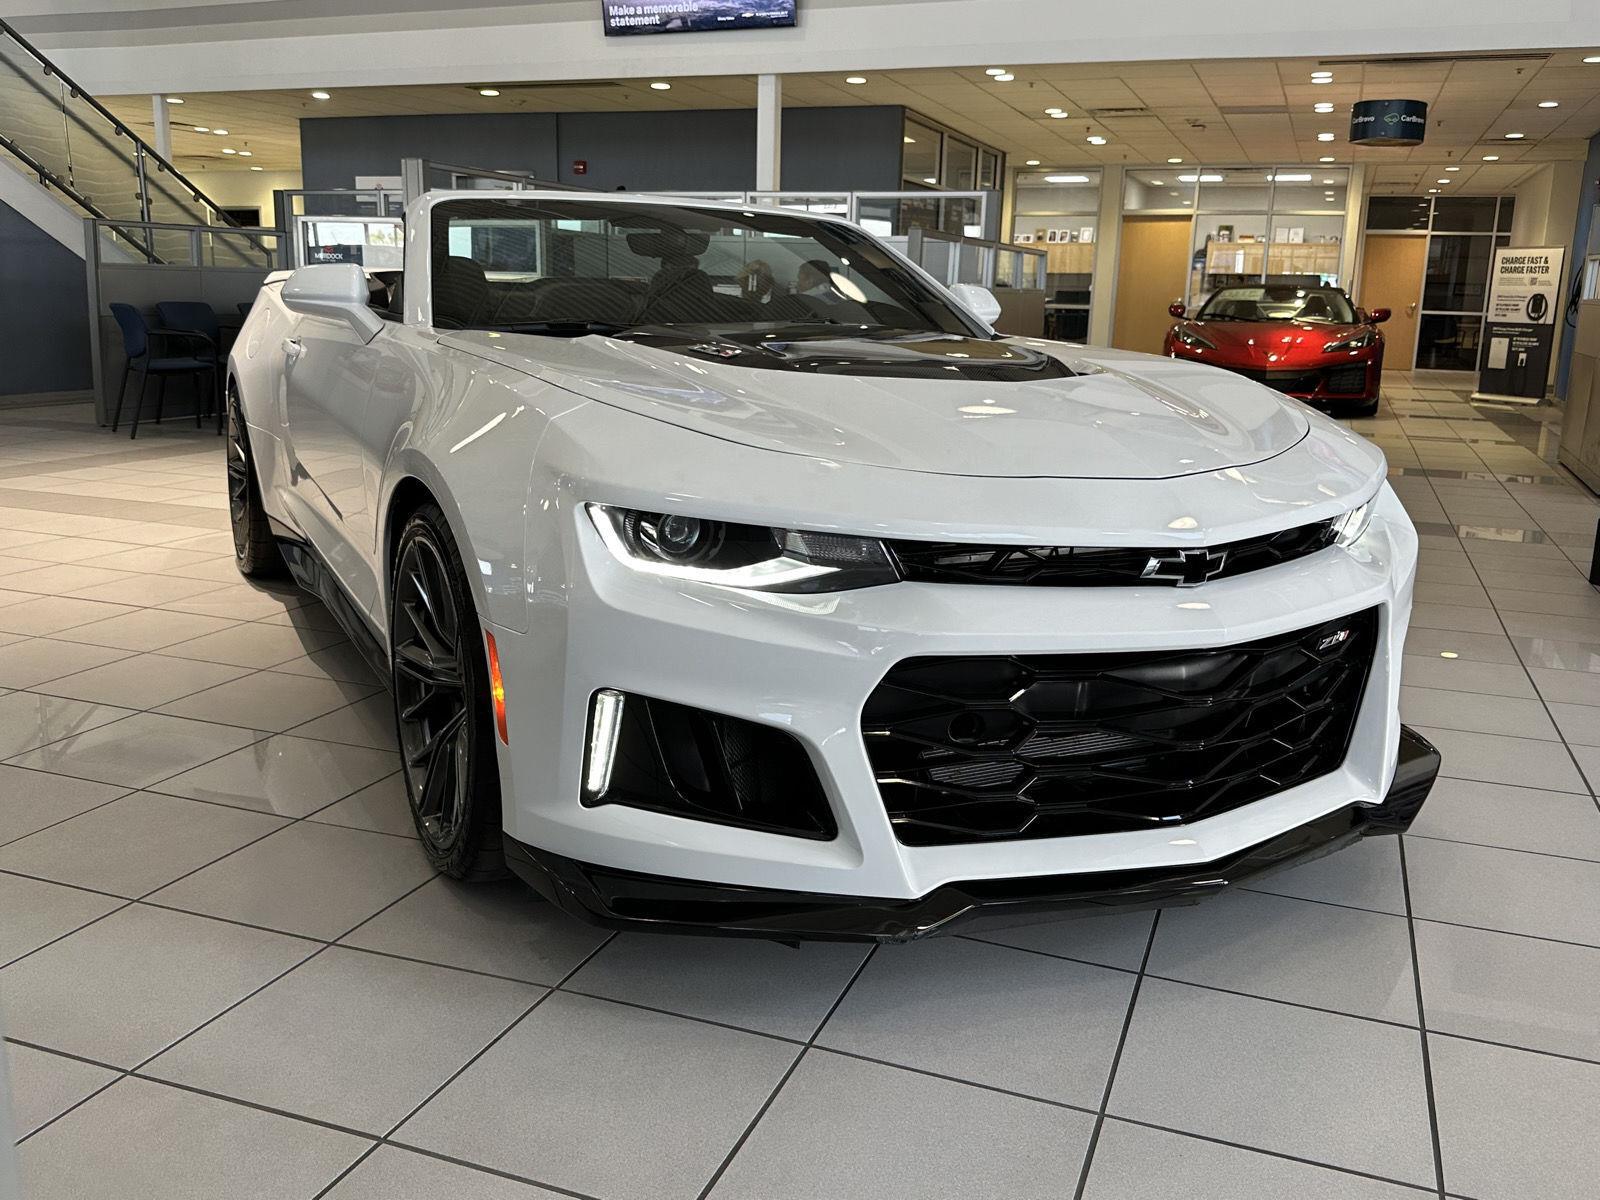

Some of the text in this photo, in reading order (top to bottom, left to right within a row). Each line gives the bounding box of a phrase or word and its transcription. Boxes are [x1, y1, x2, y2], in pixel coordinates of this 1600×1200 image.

[609, 2, 699, 16] Make a memorable
[610, 15, 660, 27] statement
[1501, 256, 1549, 265] CHARGE FAST &
[1500, 266, 1550, 274] CHARGE FASTER
